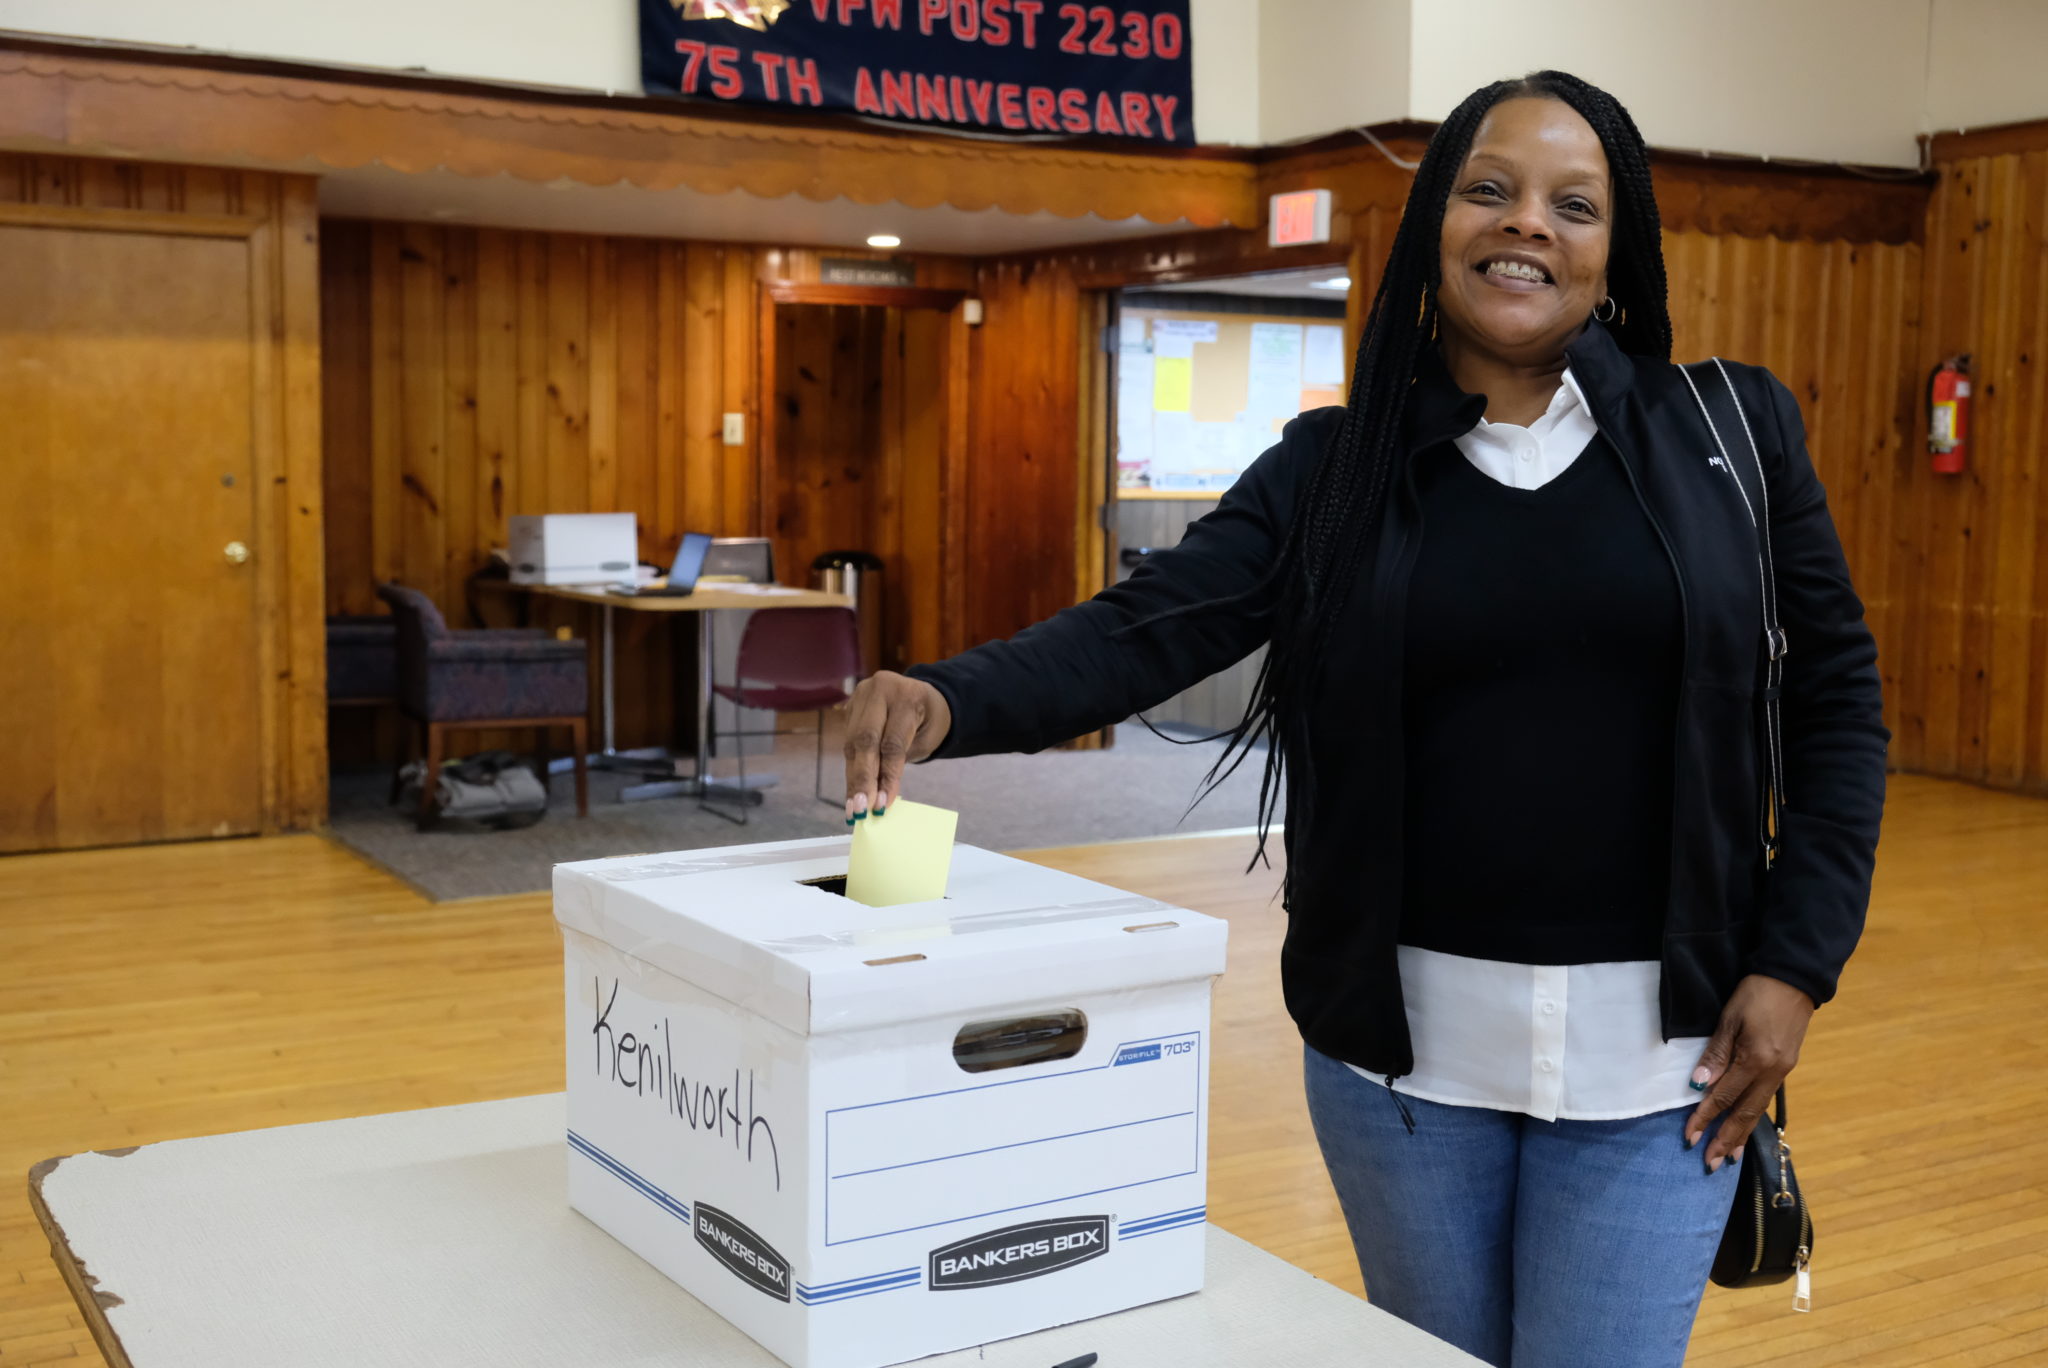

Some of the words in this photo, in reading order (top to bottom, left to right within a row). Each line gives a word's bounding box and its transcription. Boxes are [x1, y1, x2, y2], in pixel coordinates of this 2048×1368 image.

[919, 0, 1044, 49] POST
[1059, 4, 1182, 60] 2230
[675, 39, 744, 99] 75
[752, 50, 823, 106] TH
[854, 66, 1178, 141] ANNIVERSARY
[592, 975, 780, 1192] Kenilworth
[699, 1215, 757, 1268] BANKERS
[757, 1255, 786, 1288] BOX
[940, 1239, 1050, 1277] BANKERS
[1053, 1227, 1101, 1253] BOX
